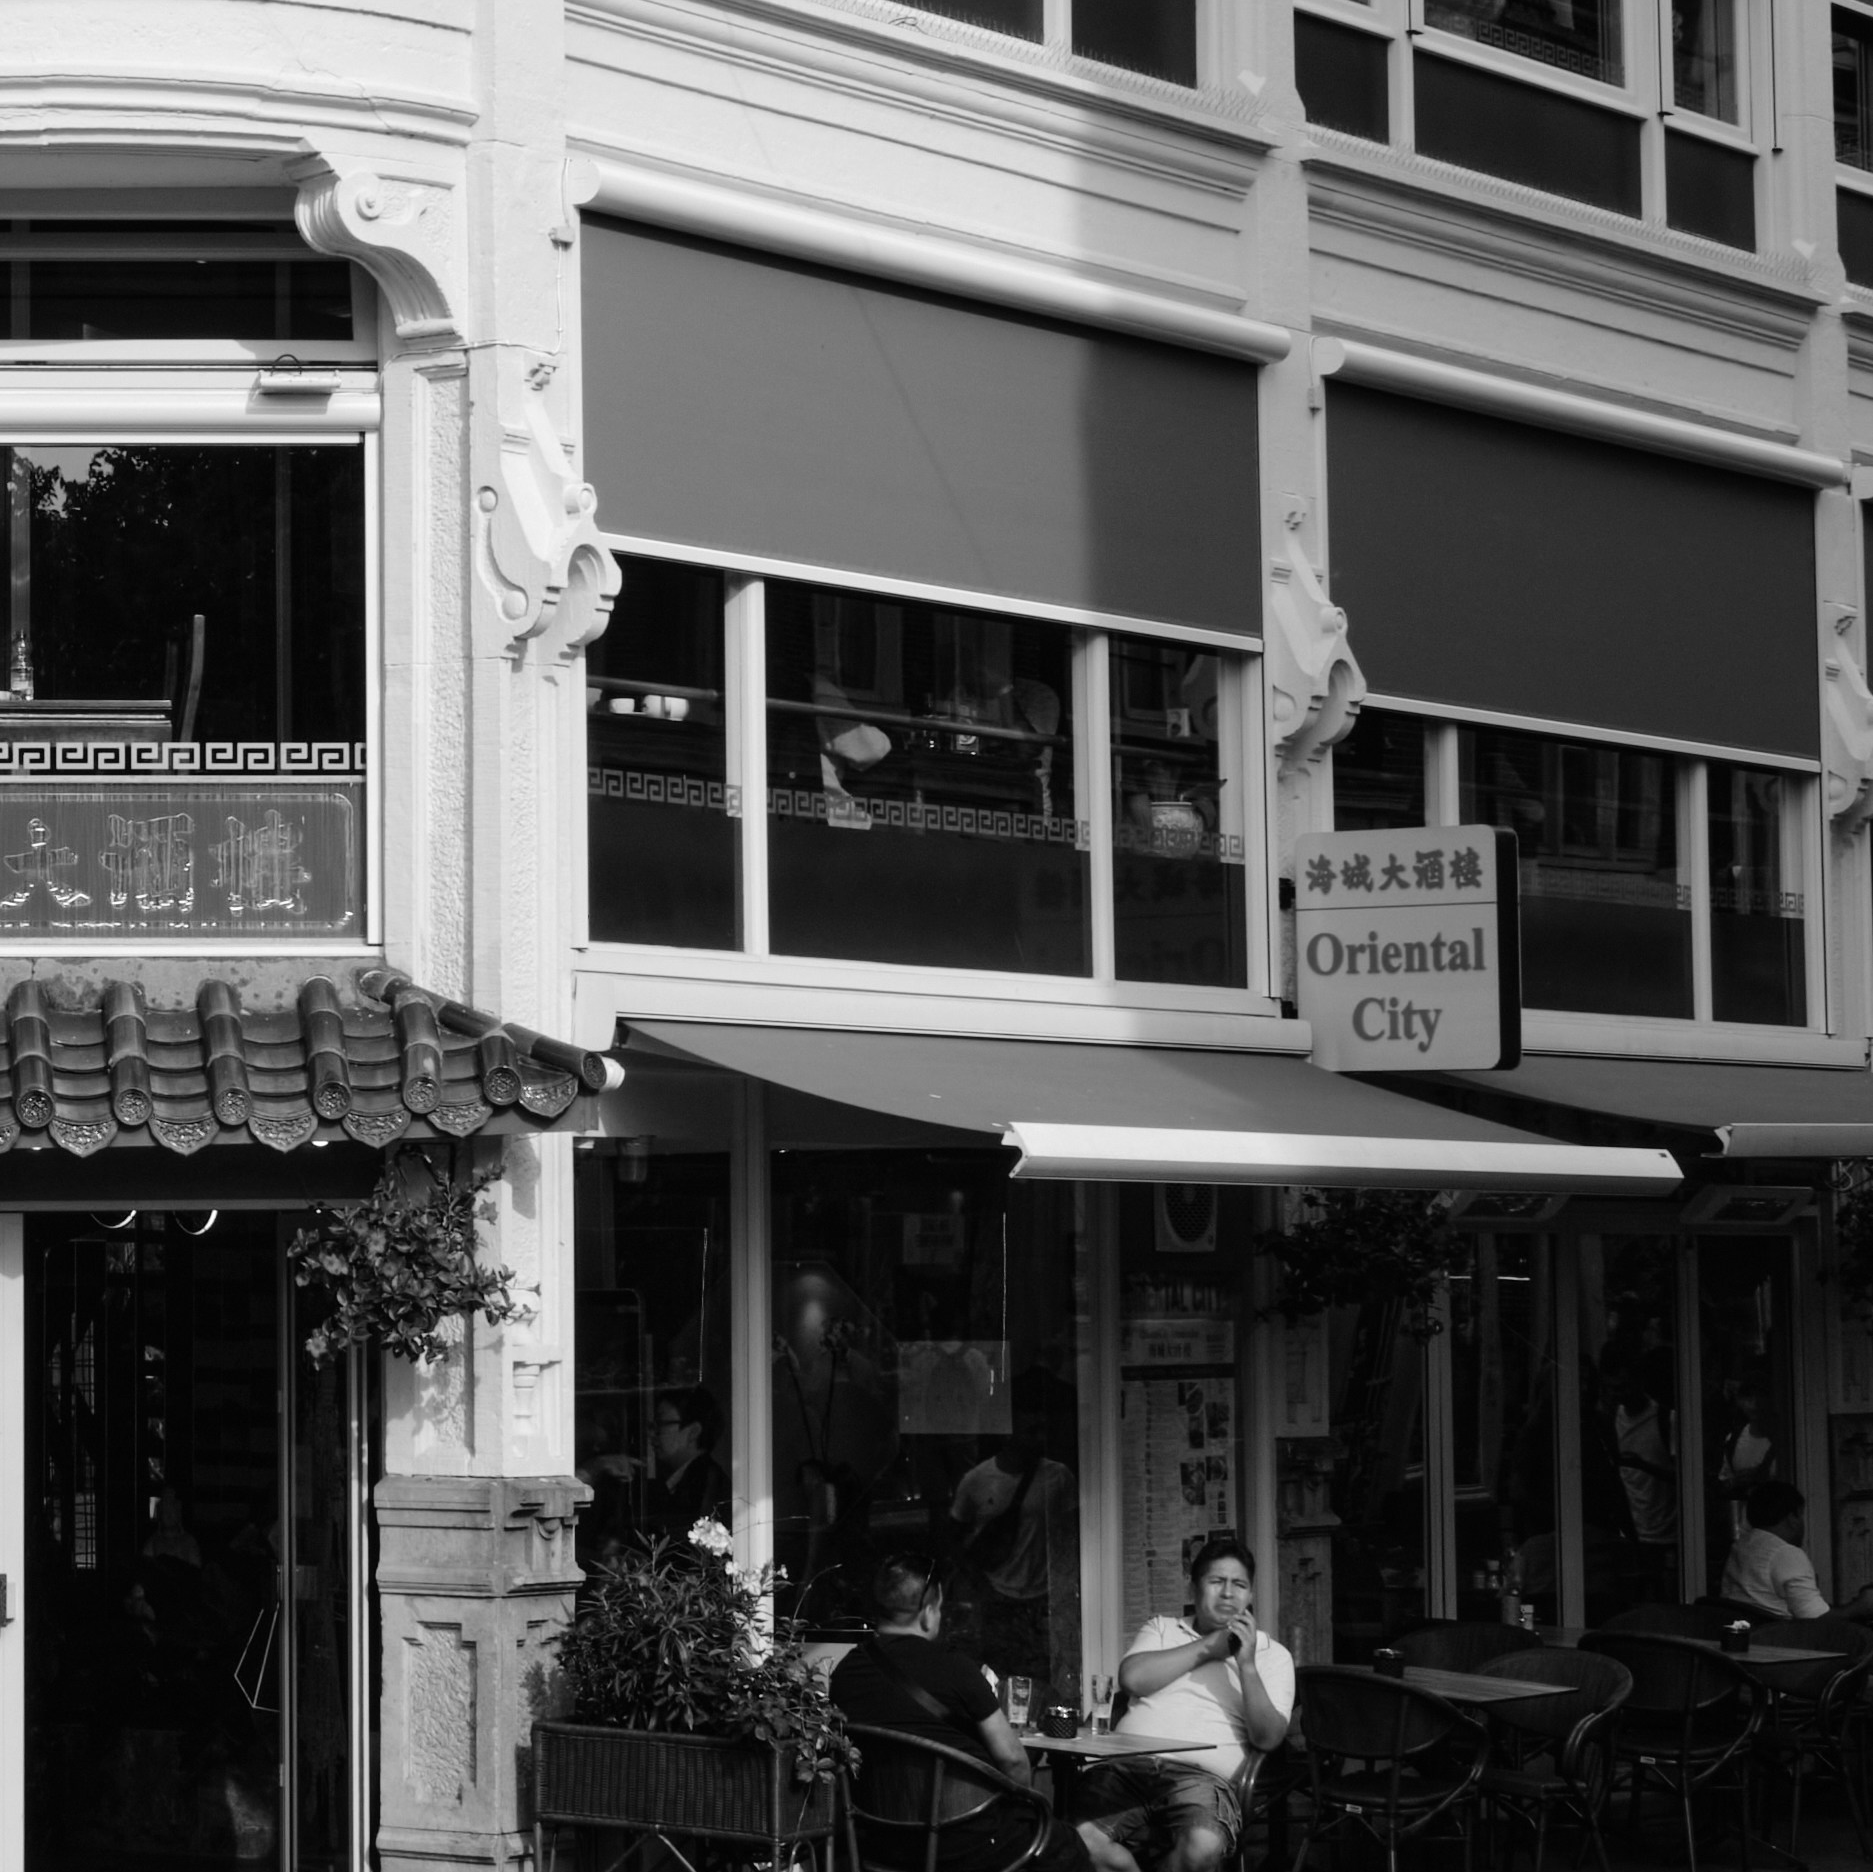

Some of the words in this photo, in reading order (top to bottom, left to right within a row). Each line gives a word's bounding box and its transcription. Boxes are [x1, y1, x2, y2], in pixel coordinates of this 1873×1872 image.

[1305, 847, 1484, 895] 海城大酒樓
[1306, 928, 1487, 976] Oriental
[1352, 996, 1443, 1053] City
